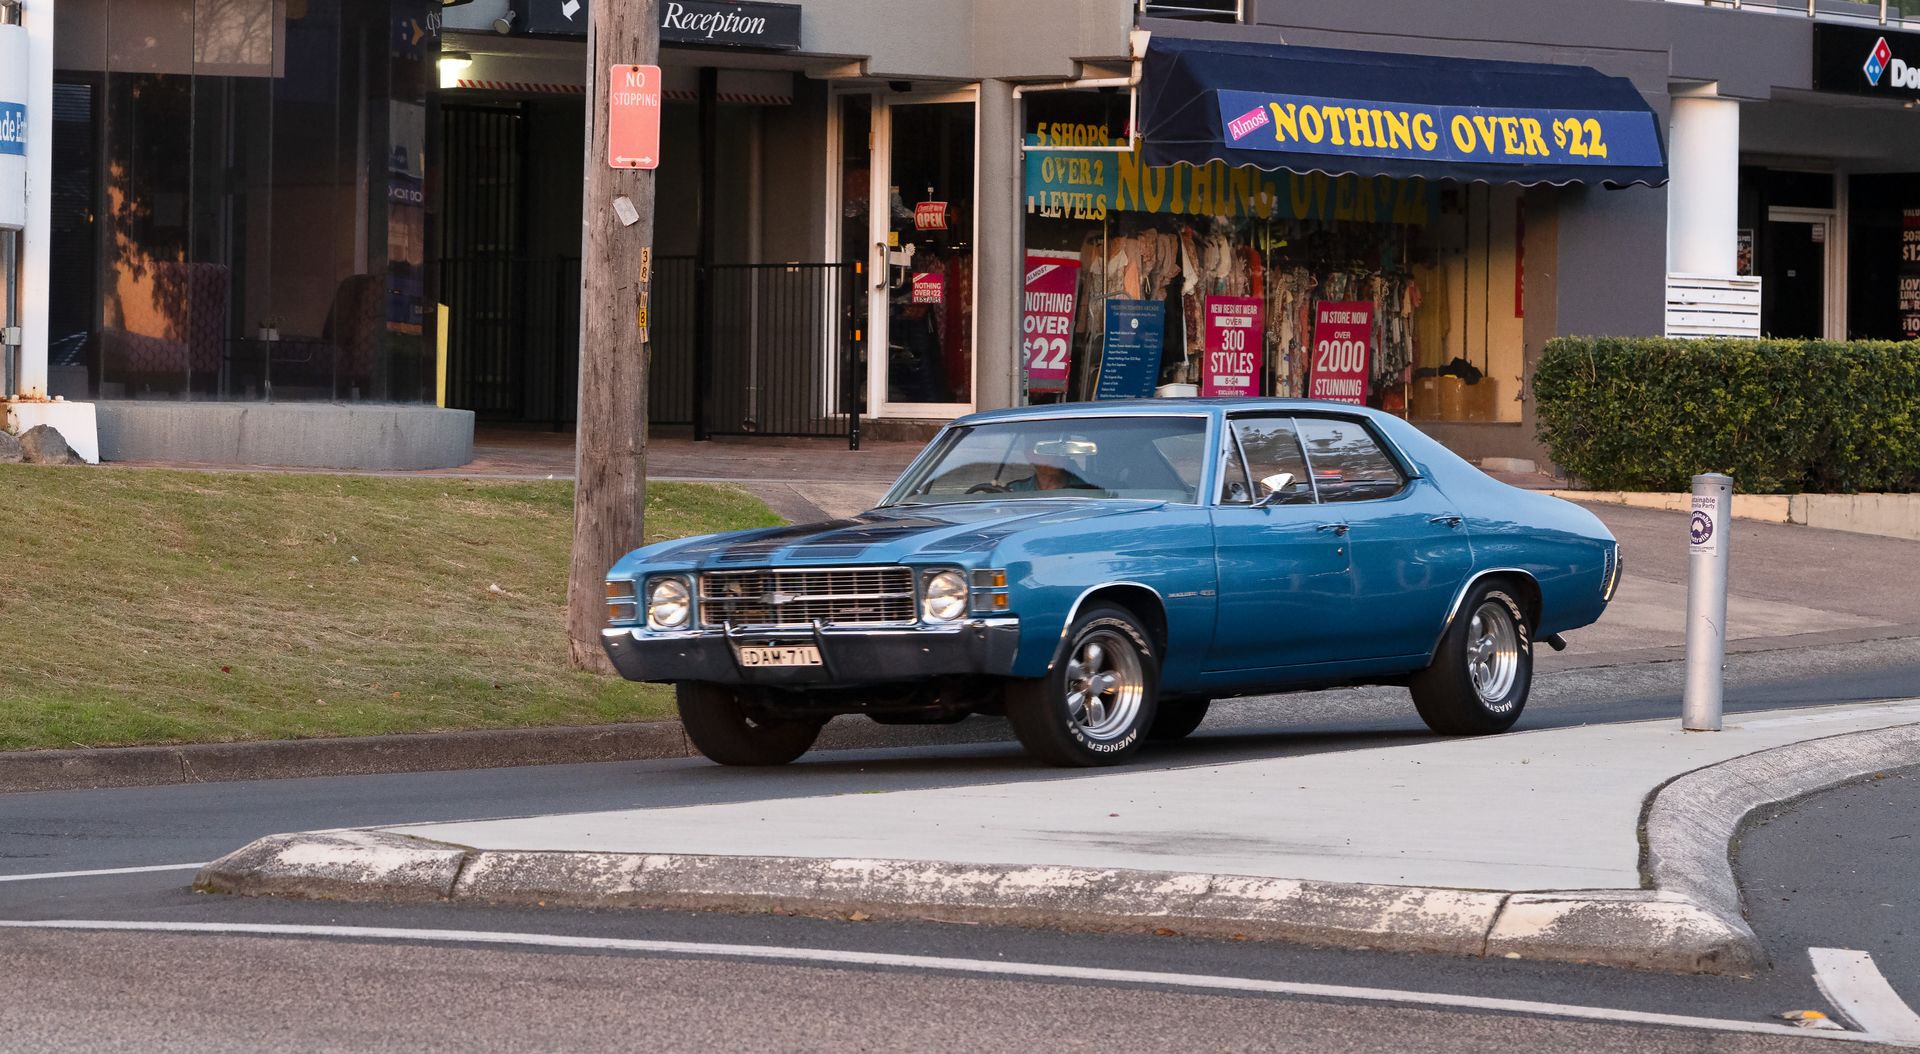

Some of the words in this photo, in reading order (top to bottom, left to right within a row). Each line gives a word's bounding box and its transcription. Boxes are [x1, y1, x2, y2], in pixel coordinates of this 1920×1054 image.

[661, 2, 766, 38] Reception
[626, 72, 645, 87] NO
[613, 92, 657, 107] STOPPING
[0, 111, 15, 142] de
[1037, 122, 1047, 147] 5
[1050, 122, 1109, 148] SHOPS
[1231, 109, 1269, 139] Almost
[1269, 102, 1438, 151] NOTHING
[1451, 114, 1550, 157] OVER
[1552, 118, 1608, 159] $22
[1041, 156, 1092, 185] OVER
[1093, 159, 1104, 186] 2
[1040, 191, 1107, 221] LEVELS
[916, 213, 943, 228] OPEN
[1027, 265, 1048, 282] ALMOST
[914, 282, 941, 290] NOTHING
[1900, 279, 1920, 290] LOV
[1025, 291, 1072, 313] NOTHING
[1211, 304, 1223, 314] NEW
[1243, 304, 1258, 314] WEAR
[1023, 315, 1069, 335] OVER
[1225, 318, 1242, 326] OVER
[1321, 311, 1328, 323] IN
[1329, 311, 1350, 324] STORE
[1351, 312, 1368, 324] NOW
[1222, 329, 1245, 351] 300
[1334, 331, 1351, 339] OVER
[1023, 337, 1067, 370] $22
[1211, 351, 1254, 374] STYLES
[1317, 340, 1365, 373] 2000
[1315, 379, 1361, 396] STUNNING
[1087, 728, 1137, 753] AVENGER
